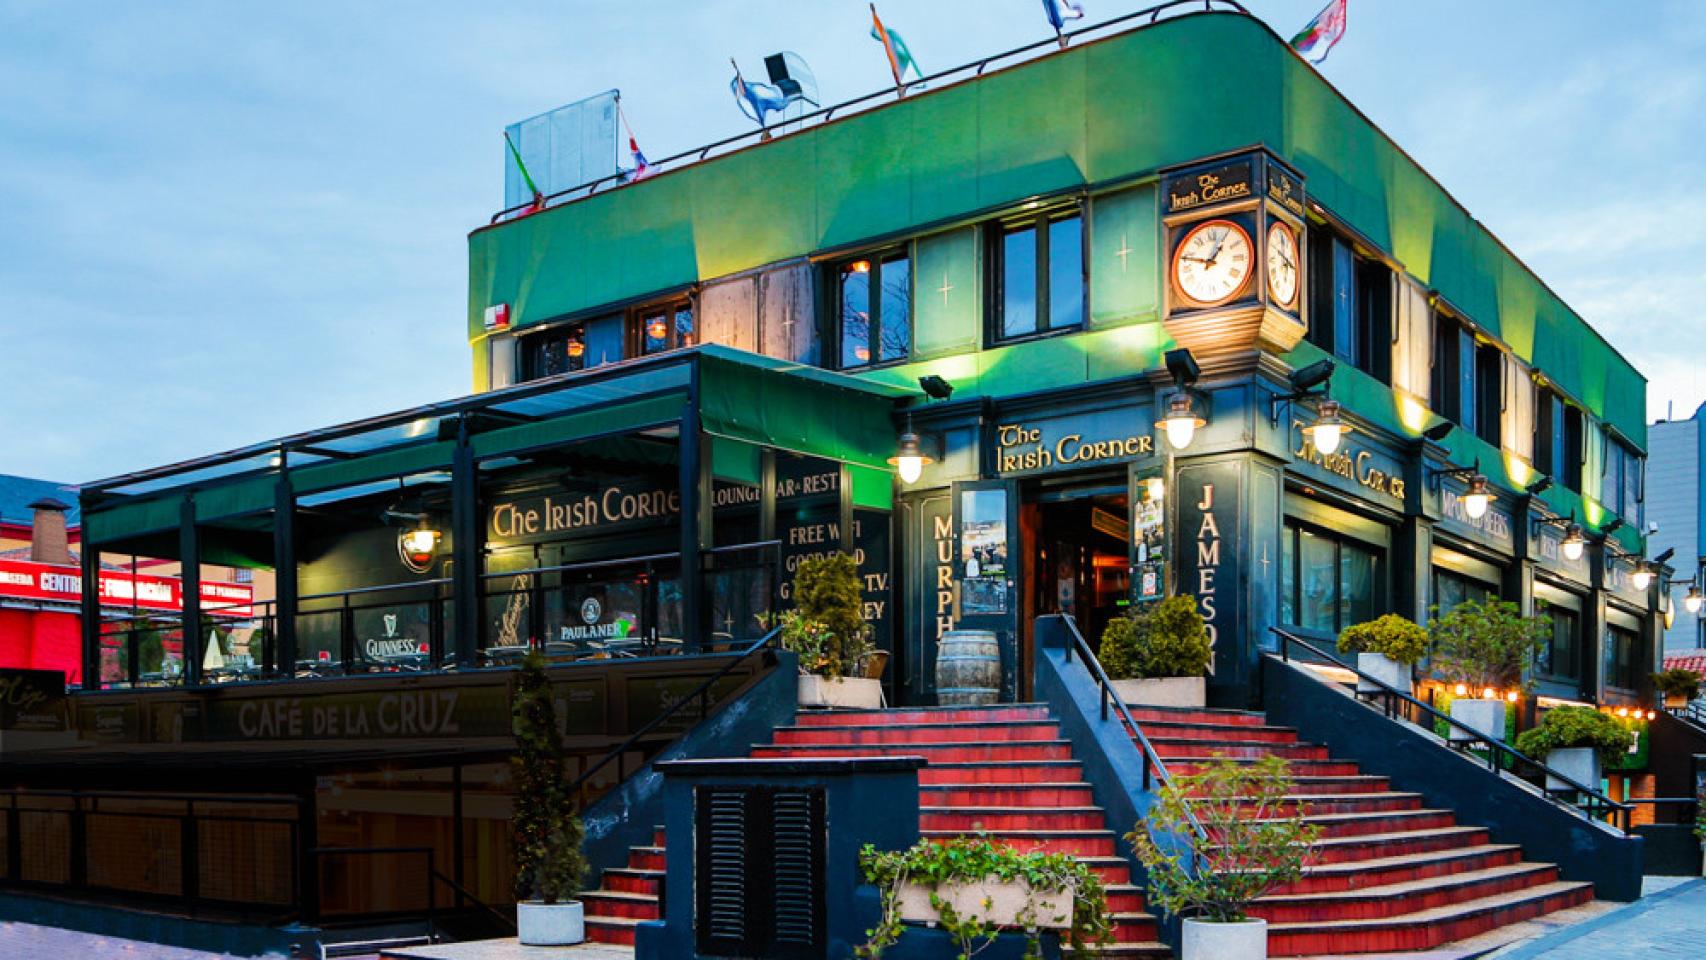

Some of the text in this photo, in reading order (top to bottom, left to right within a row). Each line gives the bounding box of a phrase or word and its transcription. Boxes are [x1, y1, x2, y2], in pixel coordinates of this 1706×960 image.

[1198, 175, 1220, 185] The
[1171, 182, 1247, 210] Irish Corner
[998, 424, 1040, 446] The
[997, 434, 1153, 473] Irish Corner
[493, 487, 681, 537] The Irish Corne
[790, 524, 826, 546] FREE
[40, 572, 83, 594] CENTR
[934, 516, 953, 647] MURPH
[560, 622, 622, 640] PAULANER
[366, 637, 415, 659] GUINNESS
[238, 689, 459, 738] CAFÉ DE LA CRUZ
